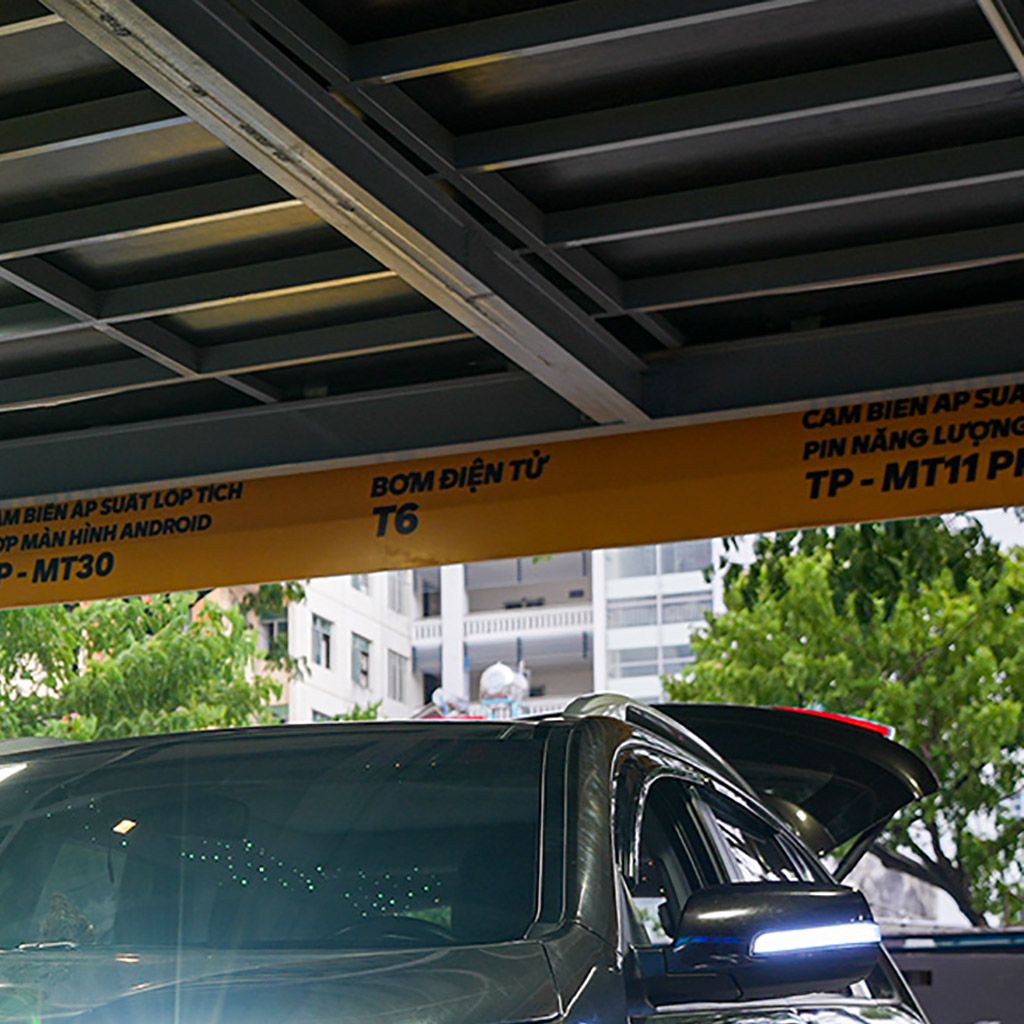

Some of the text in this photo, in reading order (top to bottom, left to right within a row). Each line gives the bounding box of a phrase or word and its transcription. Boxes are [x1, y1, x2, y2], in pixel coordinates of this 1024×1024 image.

[803, 437, 846, 461] PIN
[851, 427, 929, 455] NĂNG
[370, 450, 550, 498] BƠM ĐIỆN TỬ
[805, 467, 854, 499] TP
[881, 452, 980, 492] MT11
[21, 527, 66, 551] MÀN
[68, 521, 118, 546] HÌNH
[120, 513, 213, 540] ANDROID
[372, 502, 419, 538] T6
[32, 551, 115, 584] MT30
